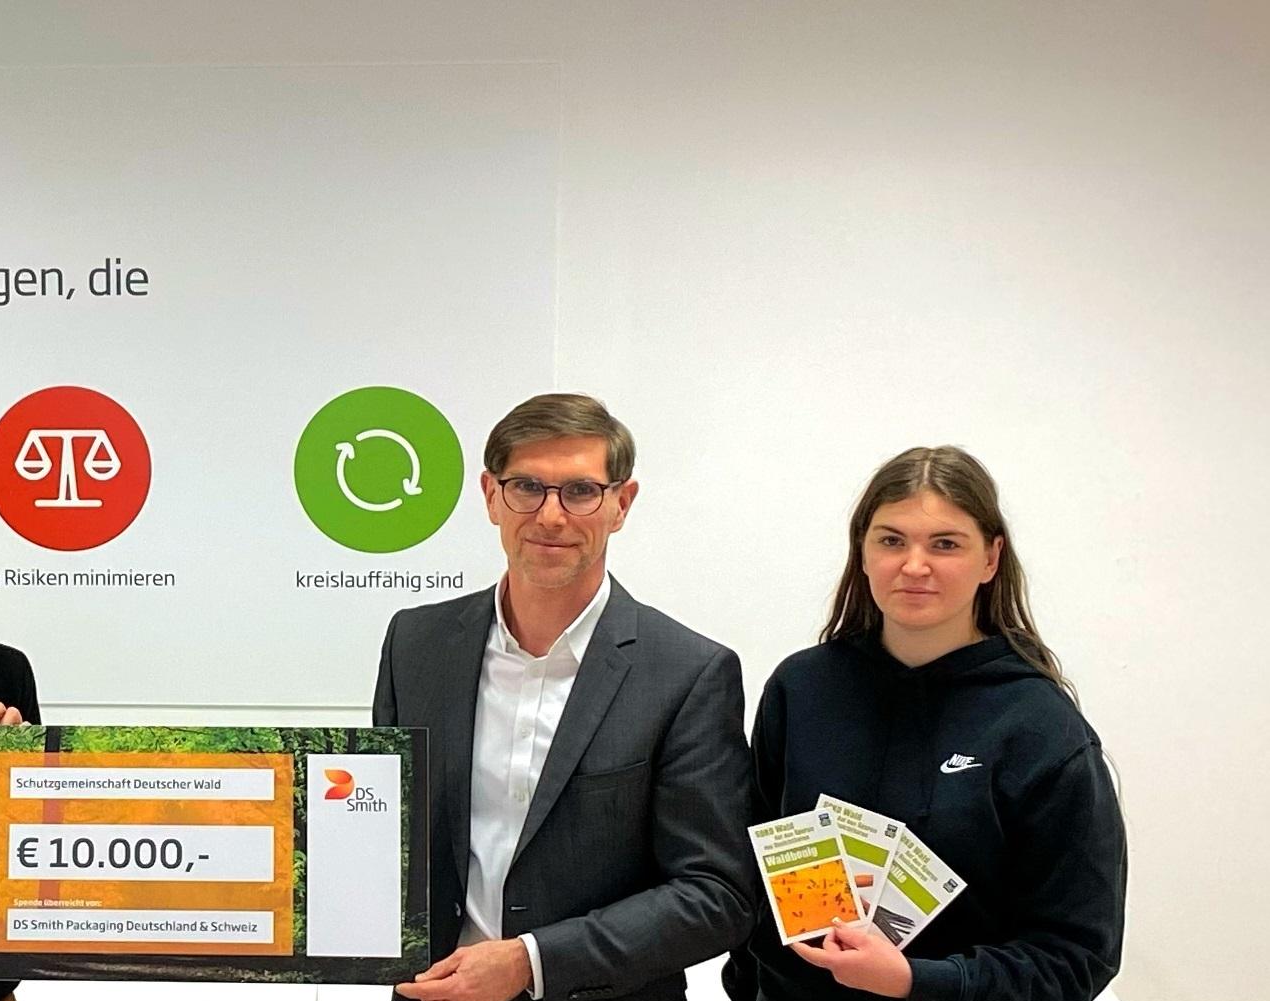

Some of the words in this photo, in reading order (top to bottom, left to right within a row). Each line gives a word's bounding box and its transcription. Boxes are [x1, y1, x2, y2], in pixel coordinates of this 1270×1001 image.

[89, 260, 150, 298] die
[4, 568, 69, 586] Risiken
[73, 568, 175, 586] minimieren
[296, 570, 422, 592] kreislauffähig
[425, 570, 464, 588] sind
[16, 777, 131, 791] Schutzgemeinschaft
[134, 777, 192, 790] Deutscher
[193, 778, 221, 791] Wald
[355, 787, 374, 800] DS
[346, 799, 387, 812] Smith
[16, 837, 38, 868] €
[48, 838, 210, 872] 10.000,-
[765, 846, 818, 867] Waldhonig
[13, 898, 42, 908] Spende
[44, 898, 83, 907] überreicht
[13, 919, 29, 931] DS
[31, 919, 64, 932] Smith
[66, 919, 124, 935] Packaging
[126, 920, 197, 933] Deutschland
[199, 921, 209, 933] &
[211, 920, 258, 934] Schweiz
